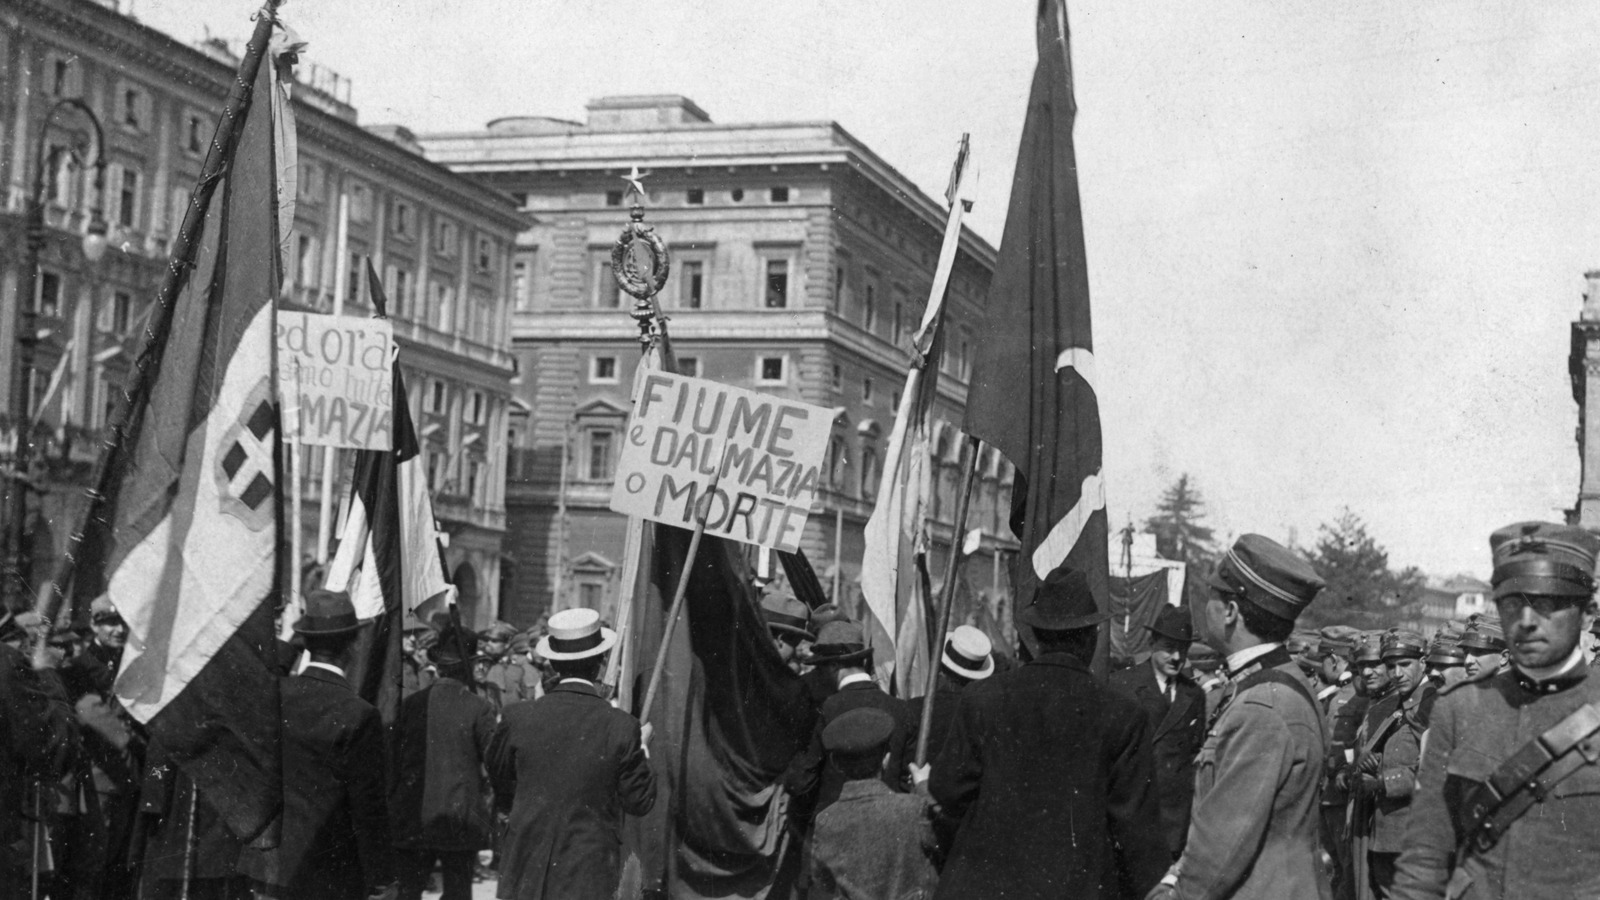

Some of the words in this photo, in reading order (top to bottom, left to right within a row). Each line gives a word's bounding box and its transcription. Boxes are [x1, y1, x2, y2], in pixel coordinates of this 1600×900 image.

[320, 328, 389, 372] ora
[638, 374, 809, 457] FIUME
[629, 424, 647, 447] e
[650, 425, 819, 500] DALMAZIA
[653, 473, 810, 552] MORTE
